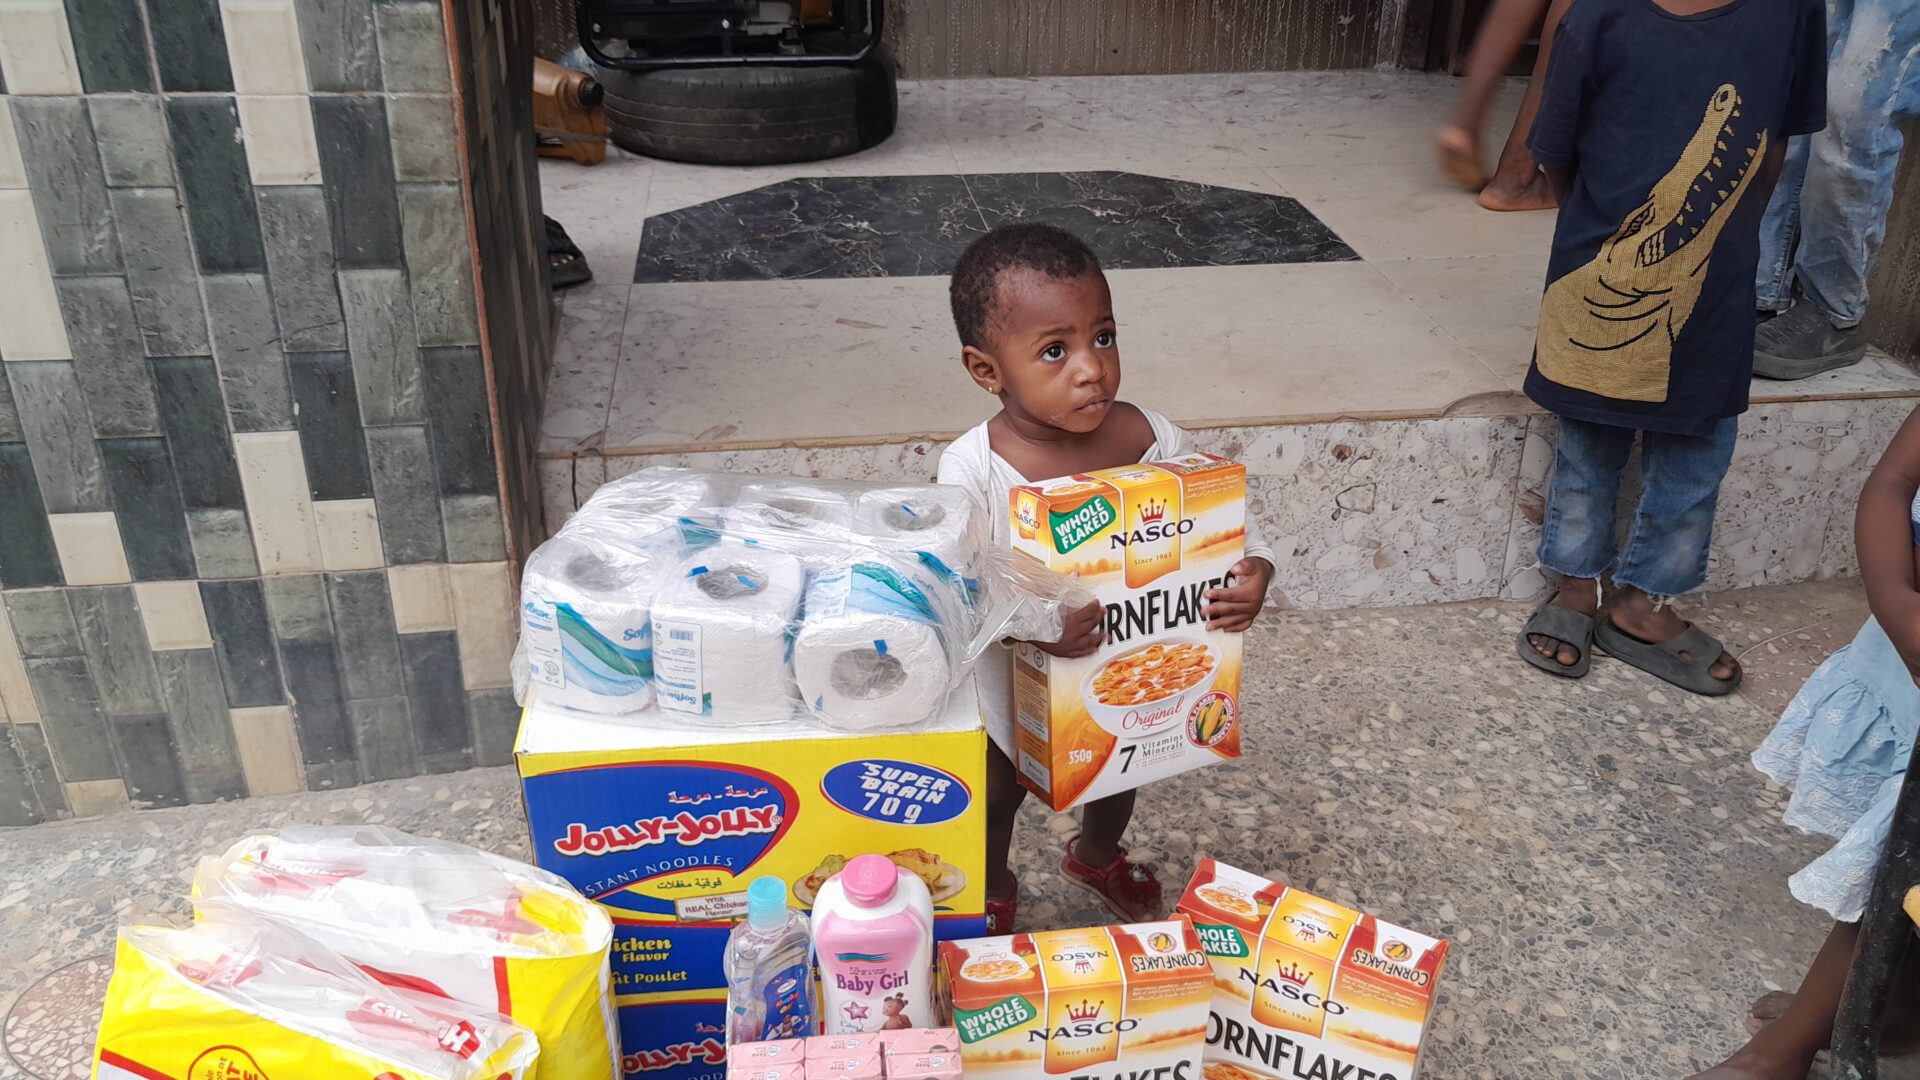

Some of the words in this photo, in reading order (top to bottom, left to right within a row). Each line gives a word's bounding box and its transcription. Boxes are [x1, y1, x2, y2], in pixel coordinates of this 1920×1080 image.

[1014, 511, 1040, 529] NASCO
[1055, 497, 1105, 537] WHOLE
[1061, 510, 1110, 550] FLAKED
[1110, 518, 1194, 550] NASCO
[1133, 556, 1153, 566] Since
[1100, 570, 1236, 645] RNFLAKE
[1122, 695, 1184, 730] Original
[1142, 734, 1183, 750] Vitamins
[1143, 741, 1183, 758] Minerals
[1068, 749, 1093, 765] 350g
[1118, 744, 1137, 774] 7
[861, 761, 952, 792] SUPER
[857, 775, 946, 805] BRAIN
[580, 867, 638, 897] STANT
[646, 855, 734, 875] NOODLES
[685, 904, 712, 913] REAL
[1197, 928, 1236, 942] HOLE
[1282, 915, 1338, 940] NASCO
[611, 937, 672, 952] icken
[1051, 950, 1109, 962] NASCO
[1202, 940, 1241, 954] AKED
[622, 952, 670, 963] Flavor
[1132, 950, 1206, 973] CORNFLAKES
[1352, 949, 1429, 986] CORNFLAKES
[634, 970, 688, 984] Poulet
[836, 973, 875, 996] Baby
[880, 970, 909, 990] Girl
[1238, 967, 1345, 1016] NASCO
[960, 997, 1022, 1031] WHOLE
[1263, 1000, 1287, 1014] Since
[1291, 1010, 1313, 1023] 1963
[967, 1008, 1029, 1041] FLAKED
[1027, 1018, 1138, 1043] NASCO
[622, 1037, 727, 1074] OLLY-J
[1056, 1048, 1081, 1057] Since
[1205, 1010, 1398, 1080] ORNFLAK
